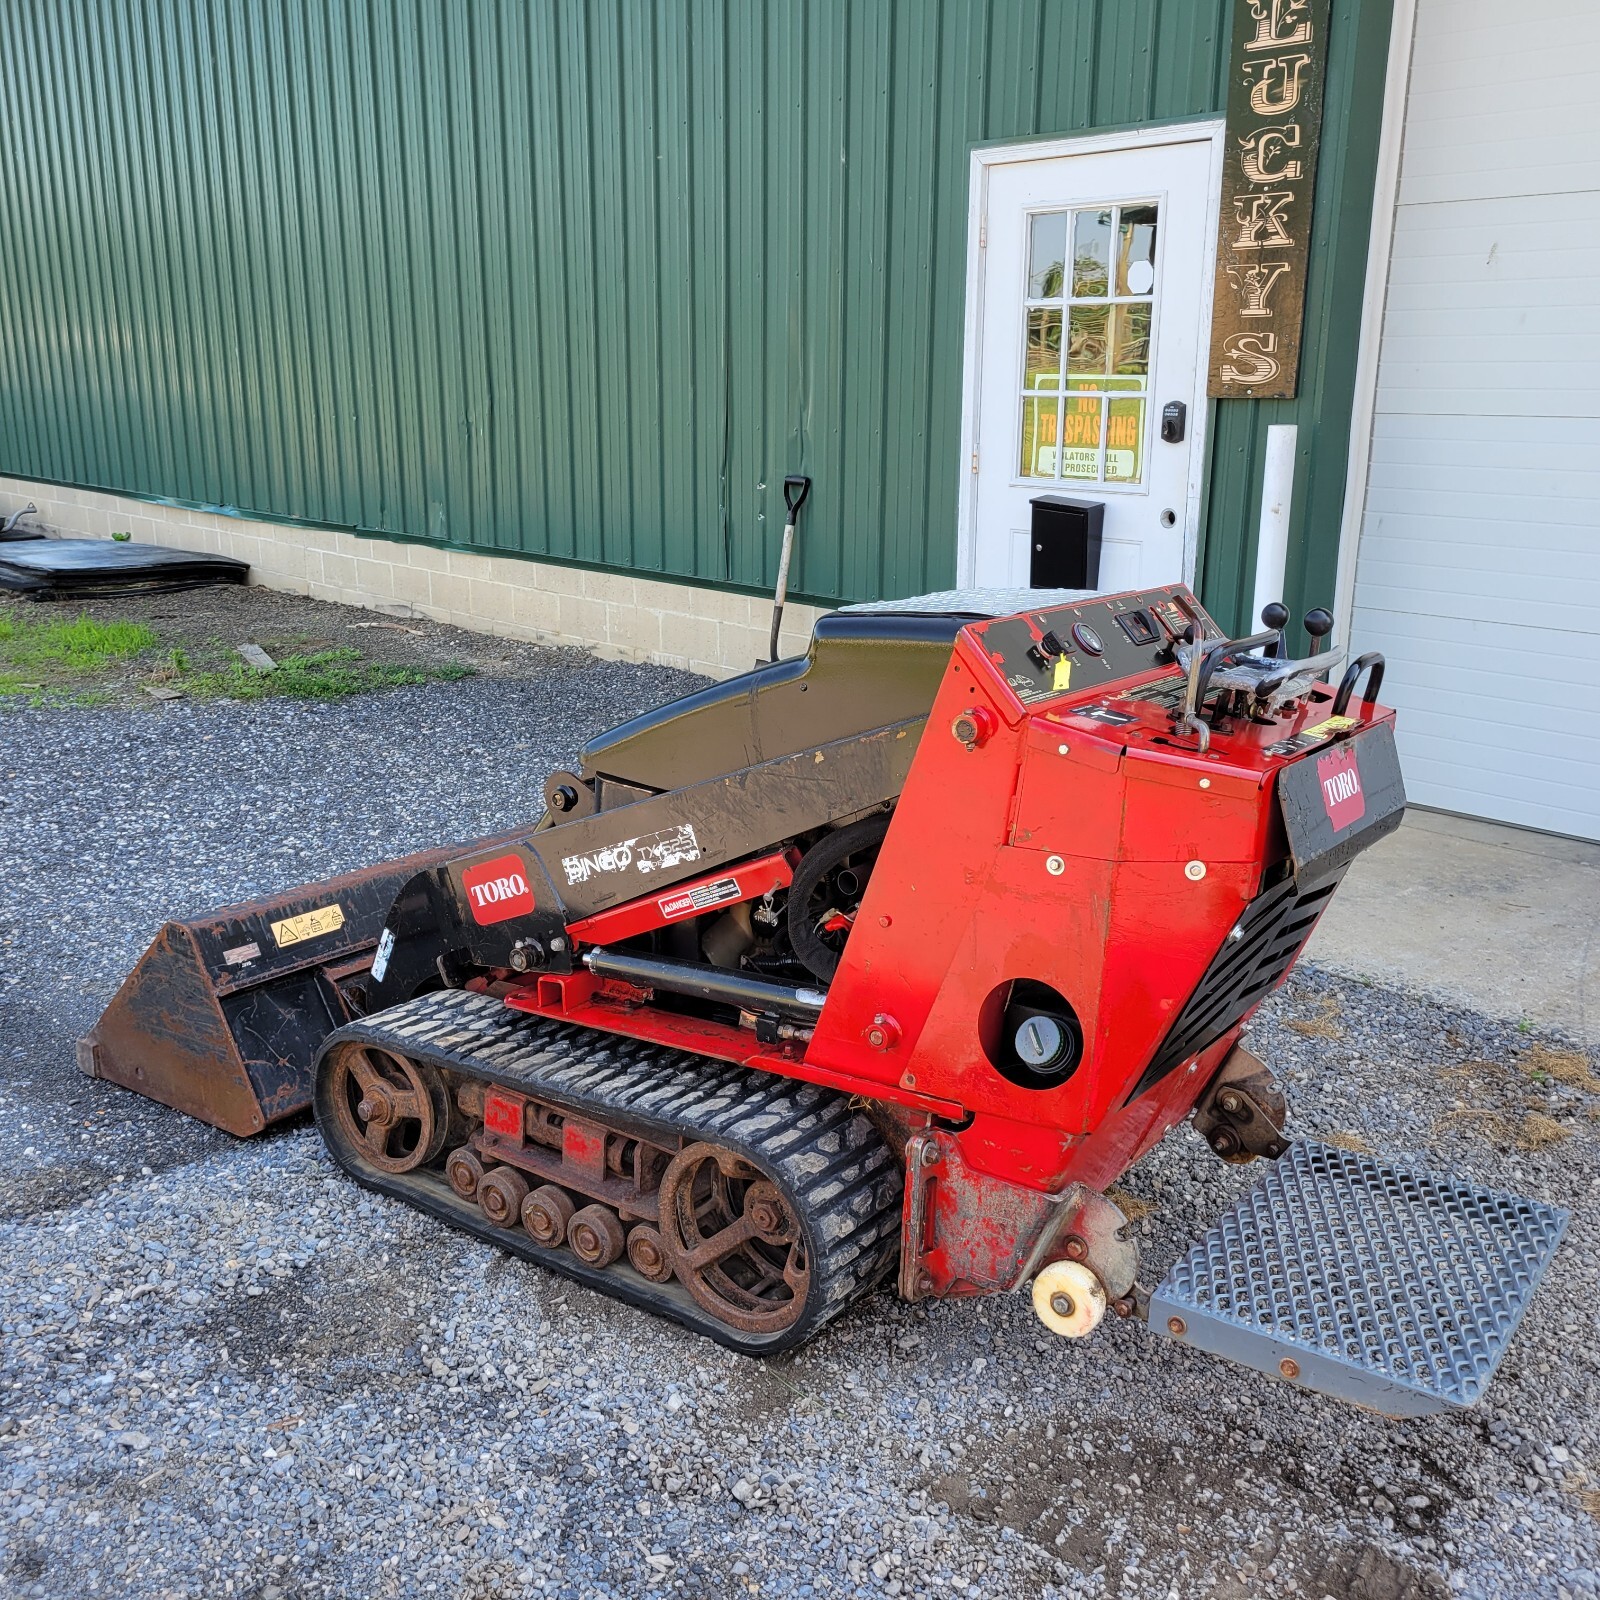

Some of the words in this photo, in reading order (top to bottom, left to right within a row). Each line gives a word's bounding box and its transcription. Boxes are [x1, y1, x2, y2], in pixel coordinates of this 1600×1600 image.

[1077, 383, 1098, 413] NO
[1040, 413, 1137, 446] TRSPASING
[1052, 451, 1095, 462] VLATORS
[1323, 768, 1358, 807] TORO
[471, 873, 525, 907] TORO
[668, 897, 693, 912] DANGER
